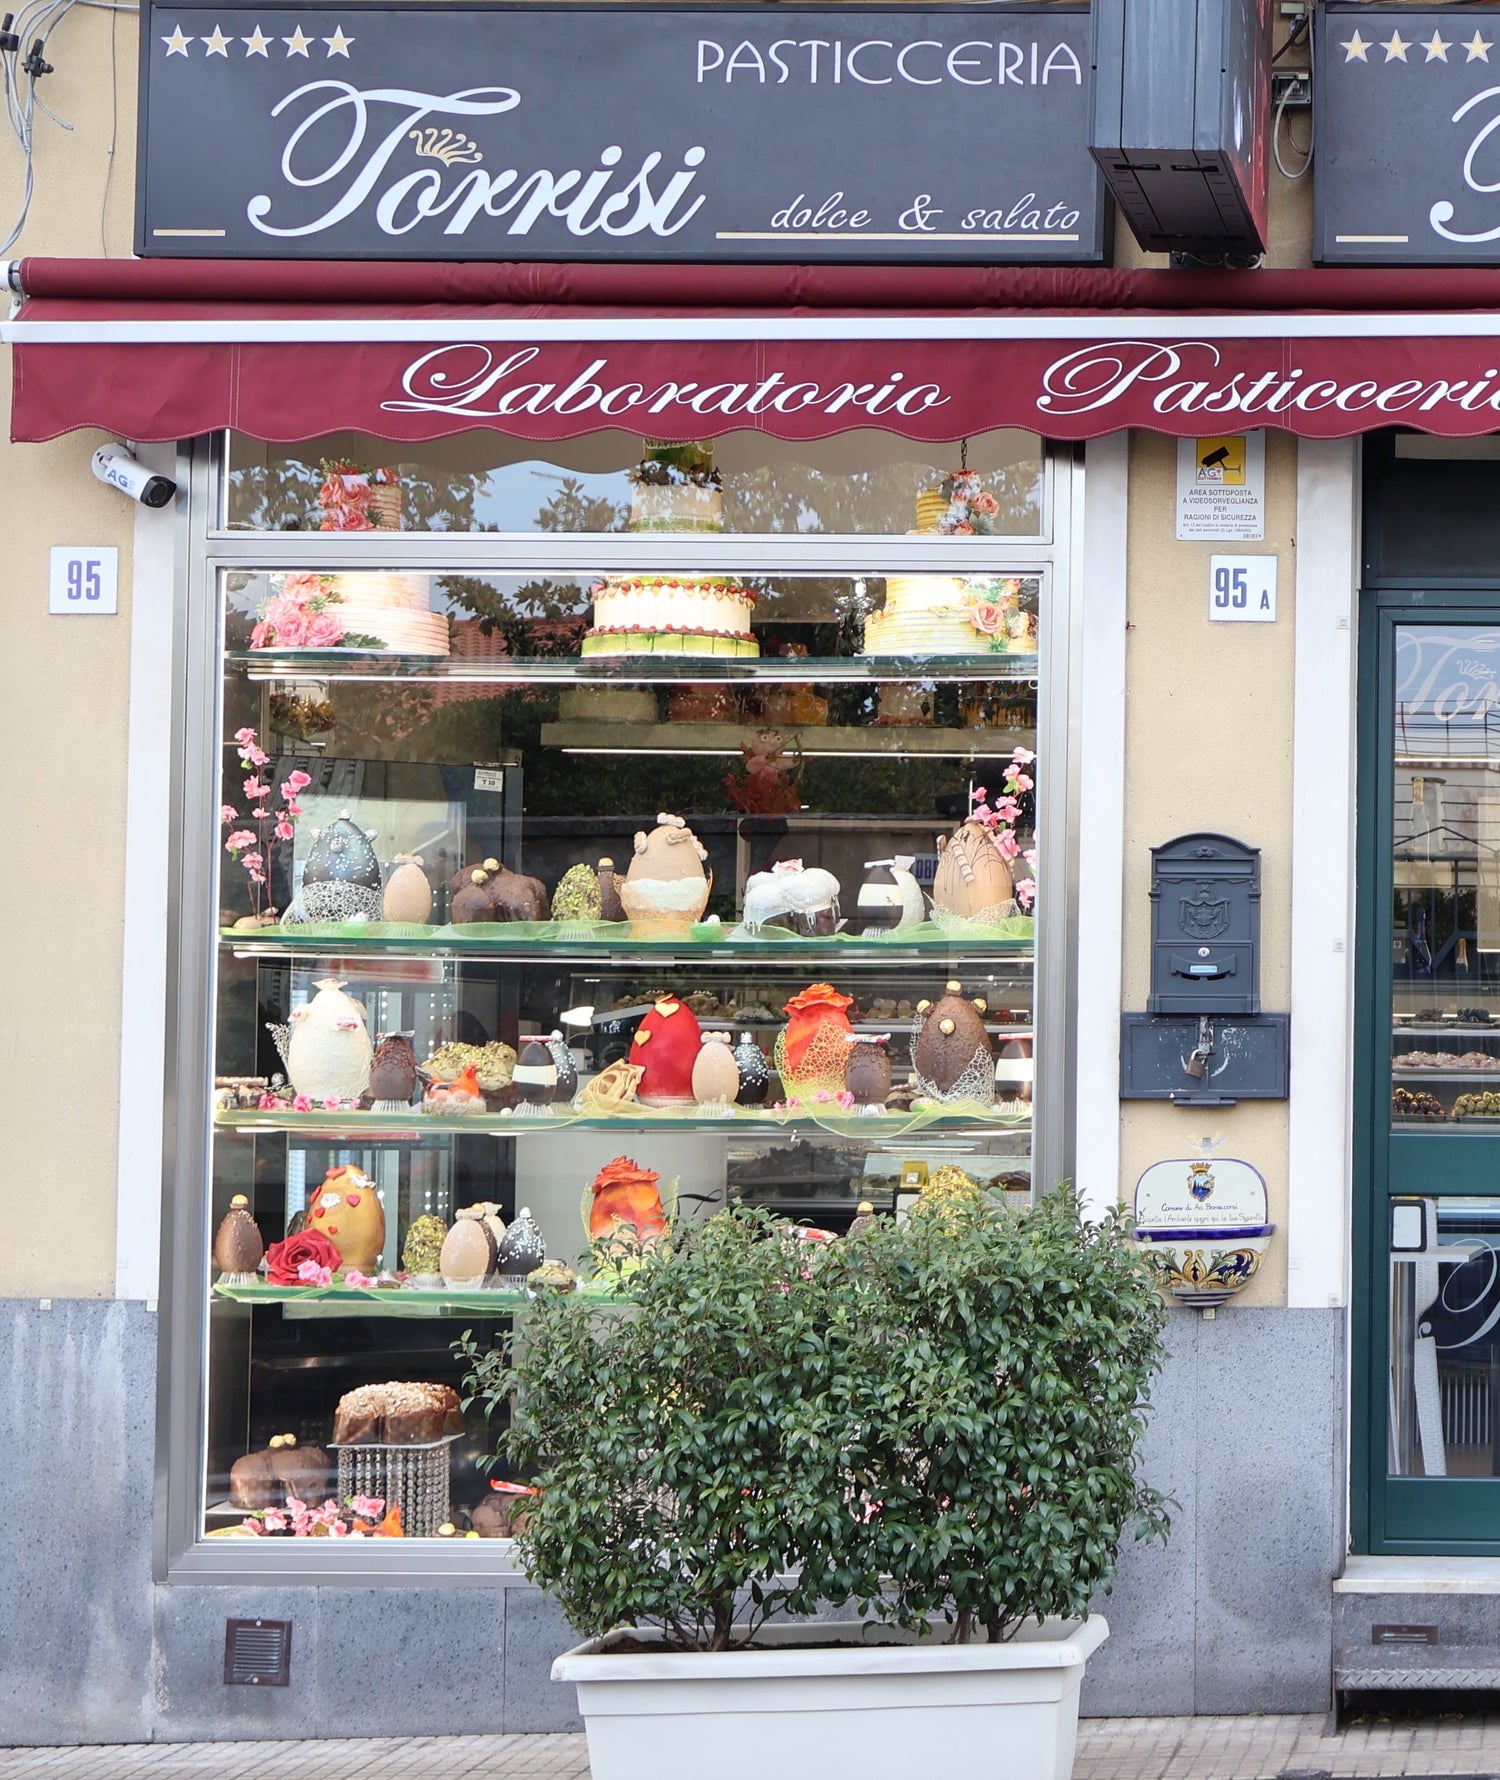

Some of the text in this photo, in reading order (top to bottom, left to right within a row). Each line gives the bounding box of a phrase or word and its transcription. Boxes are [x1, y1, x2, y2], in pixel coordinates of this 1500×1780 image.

[696, 39, 1082, 86] PASTICCERIA
[247, 79, 706, 237] Torrisi
[770, 191, 1080, 231] dolce & salato
[380, 343, 951, 417] Laboratorio
[1189, 497, 1258, 505] VIDEOSORVEGLIANZA
[67, 560, 101, 601] 95
[1215, 567, 1270, 610] 95 A
